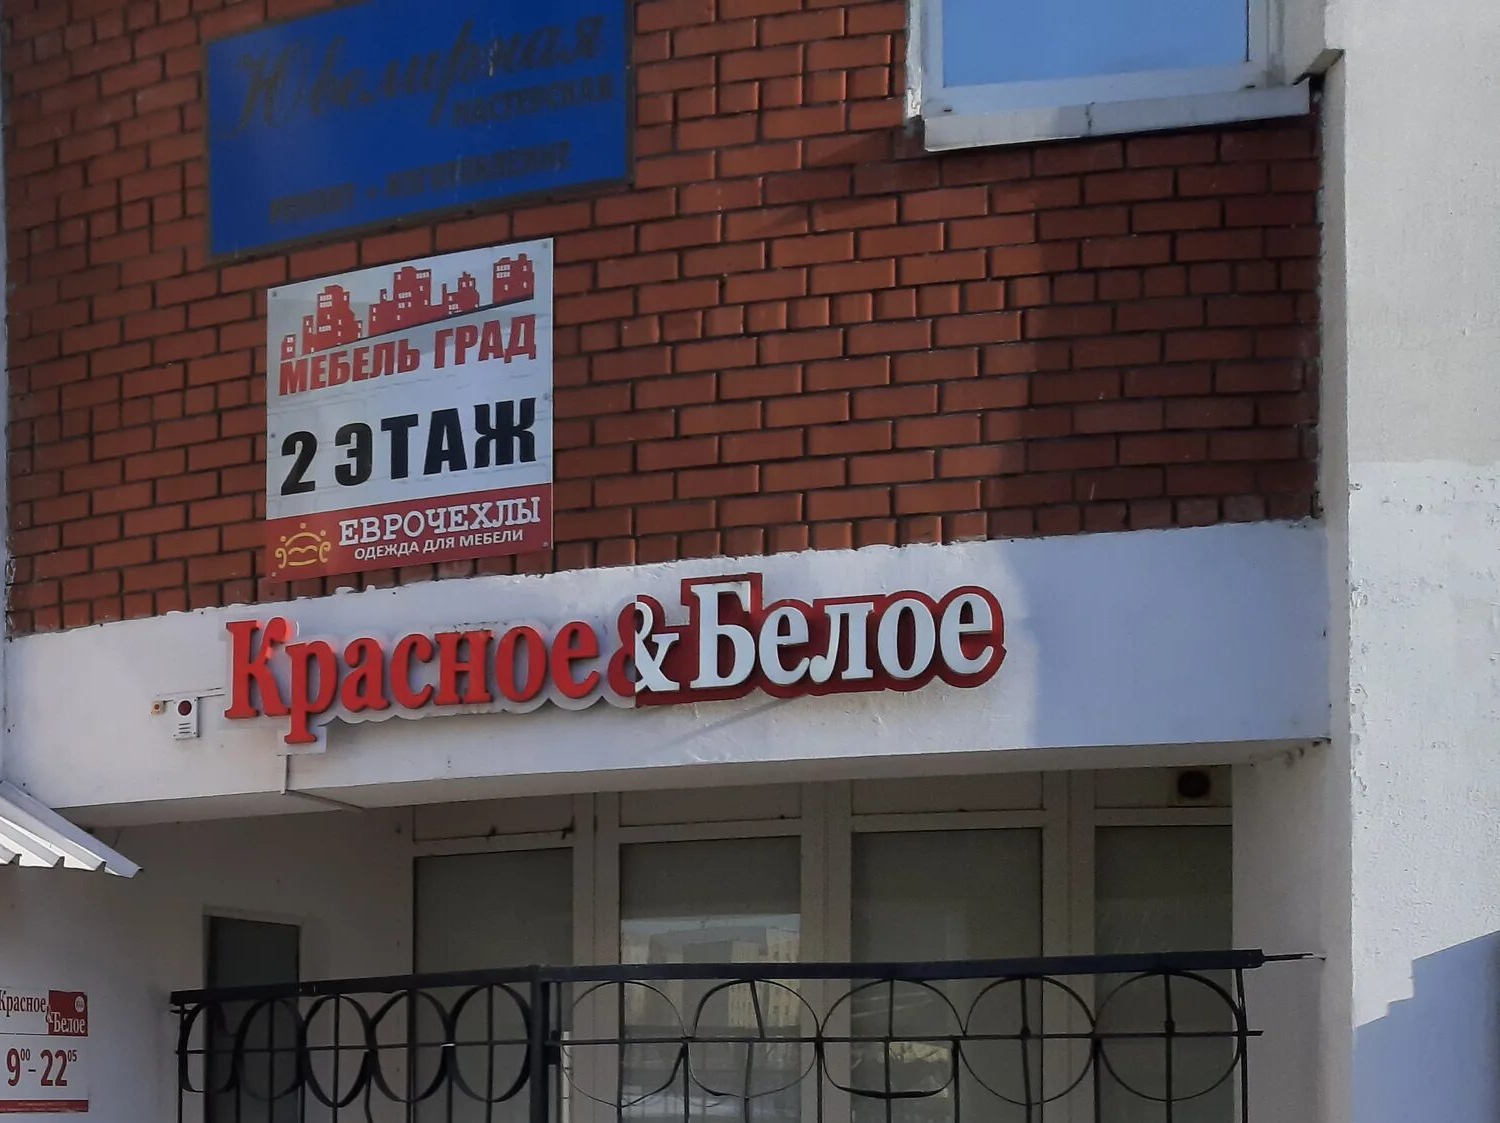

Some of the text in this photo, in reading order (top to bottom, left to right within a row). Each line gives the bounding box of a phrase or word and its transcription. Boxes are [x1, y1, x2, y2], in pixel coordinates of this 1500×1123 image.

[279, 314, 537, 396] МЕБЕЛЬ ГРАД
[281, 397, 537, 495] 2 ЭТАЖ
[338, 497, 541, 546] ЕВРОЧЕХЛЫ
[354, 529, 524, 561] ОДЕЖДА ДЛЯ МЕБЕЛИ
[51, 1011, 85, 1033] Белое
